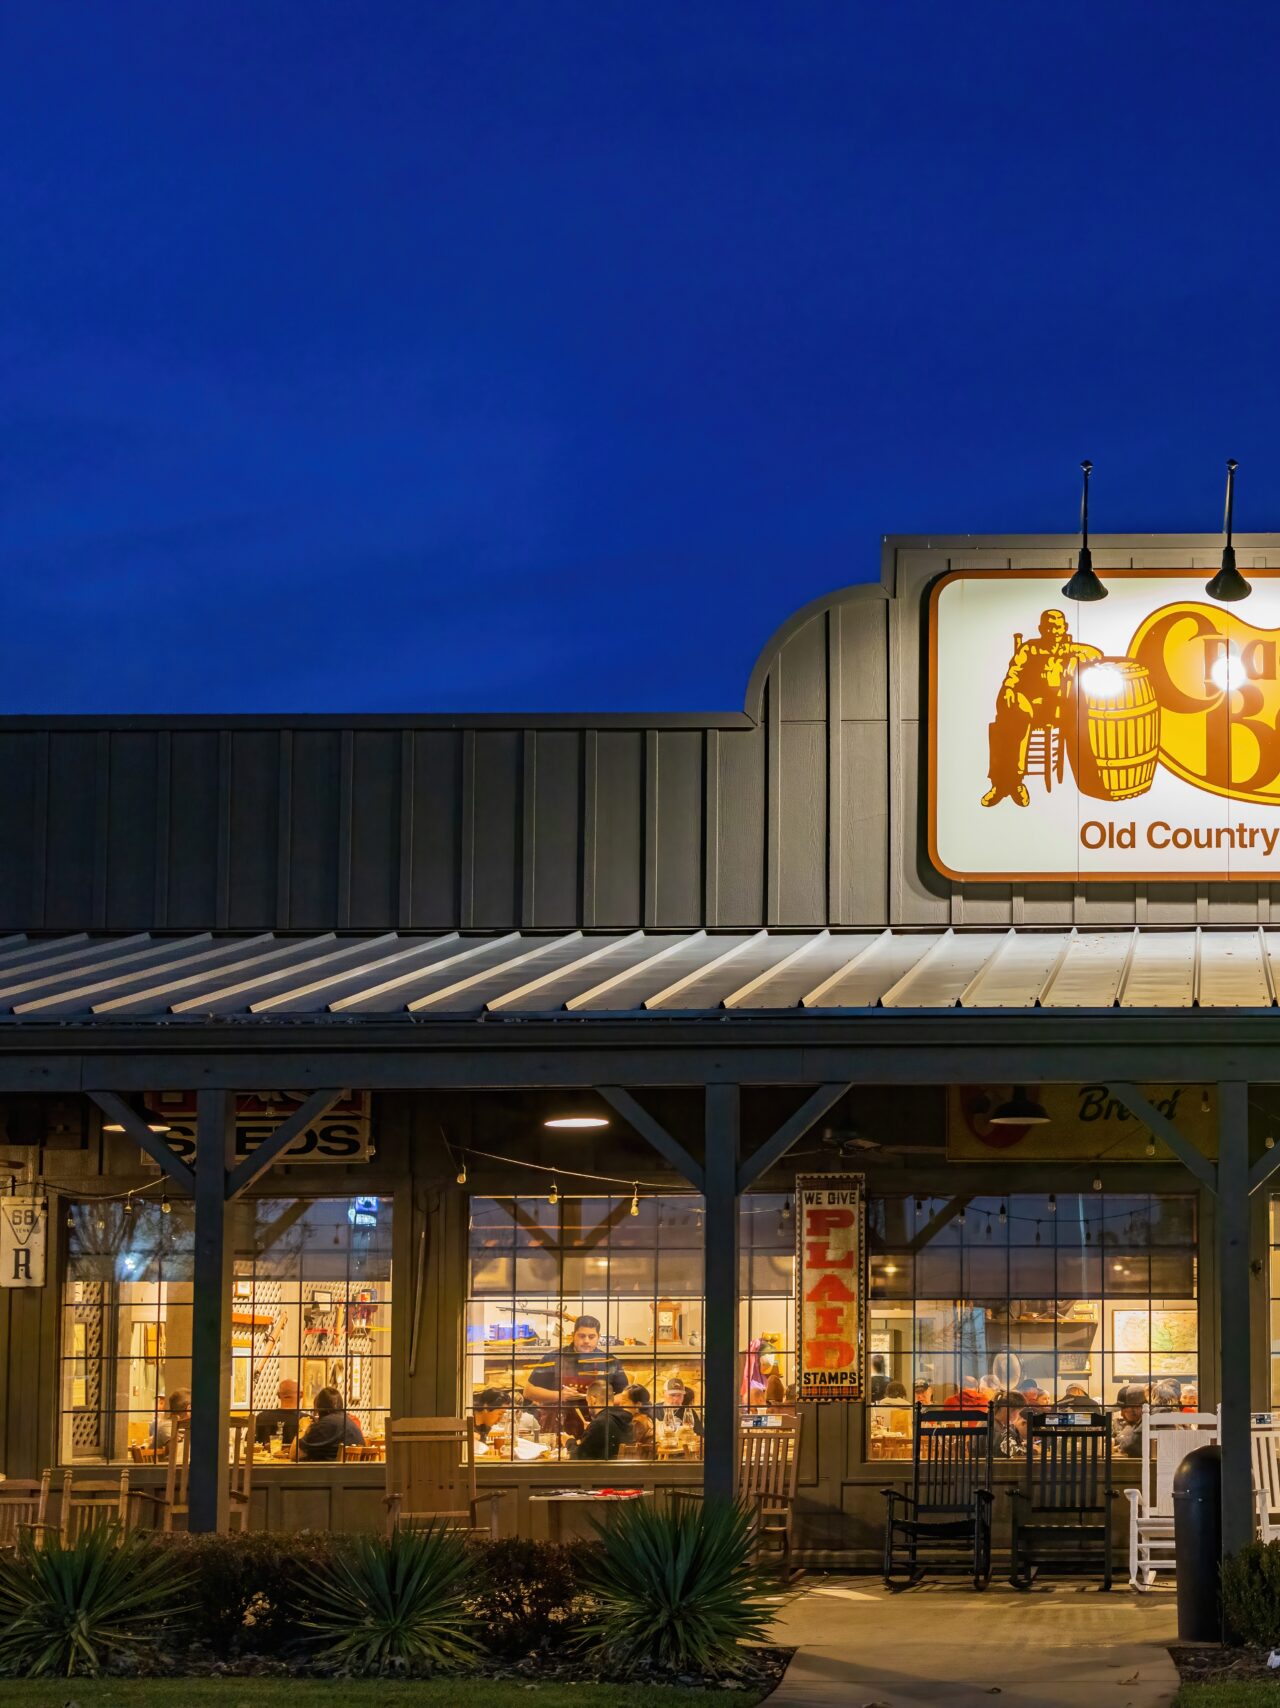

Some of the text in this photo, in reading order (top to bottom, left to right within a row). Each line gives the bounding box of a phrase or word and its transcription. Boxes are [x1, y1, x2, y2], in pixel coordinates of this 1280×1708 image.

[1080, 821, 1136, 849] Old
[1146, 821, 1280, 856] Country
[1078, 1086, 1184, 1121] Bred
[163, 1124, 361, 1156] SEDS
[804, 1191, 856, 1205] WE GIVE
[12, 1209, 34, 1226] 68
[12, 1248, 33, 1280] R
[806, 1209, 855, 1369] PLAID
[803, 1371, 857, 1385] STAMPS
